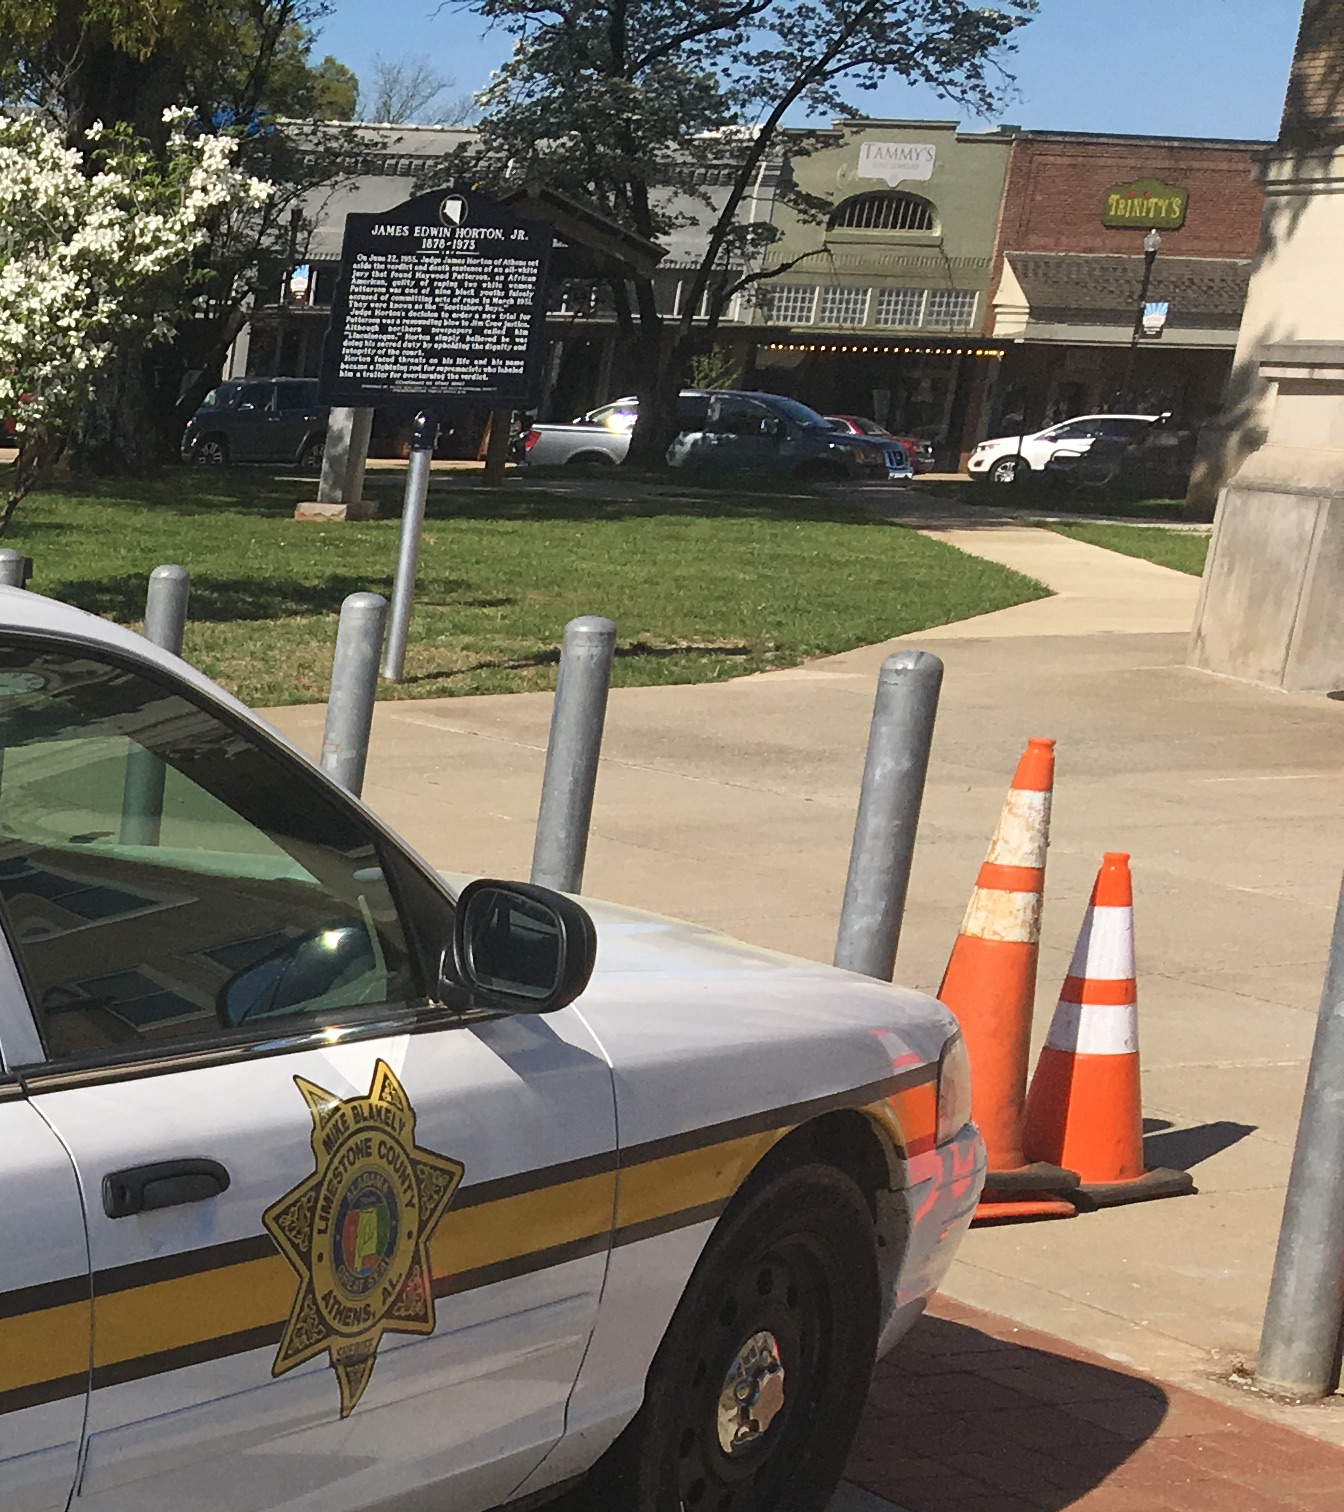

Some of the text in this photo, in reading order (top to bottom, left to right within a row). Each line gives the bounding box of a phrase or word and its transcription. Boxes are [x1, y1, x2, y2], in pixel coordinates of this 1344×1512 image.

[864, 143, 933, 162] TAMMY'S
[1108, 194, 1182, 218] TRINITY'S
[371, 225, 529, 241] JAMES EDWIN HORTON, JR.
[421, 238, 476, 250] 1878-1973
[322, 1103, 406, 1155] MIKE BLAKELY
[317, 1137, 416, 1236] LIMESTONE COUNTY
[346, 1172, 389, 1202] ALABAMA
[337, 1264, 364, 1294] GREAT
